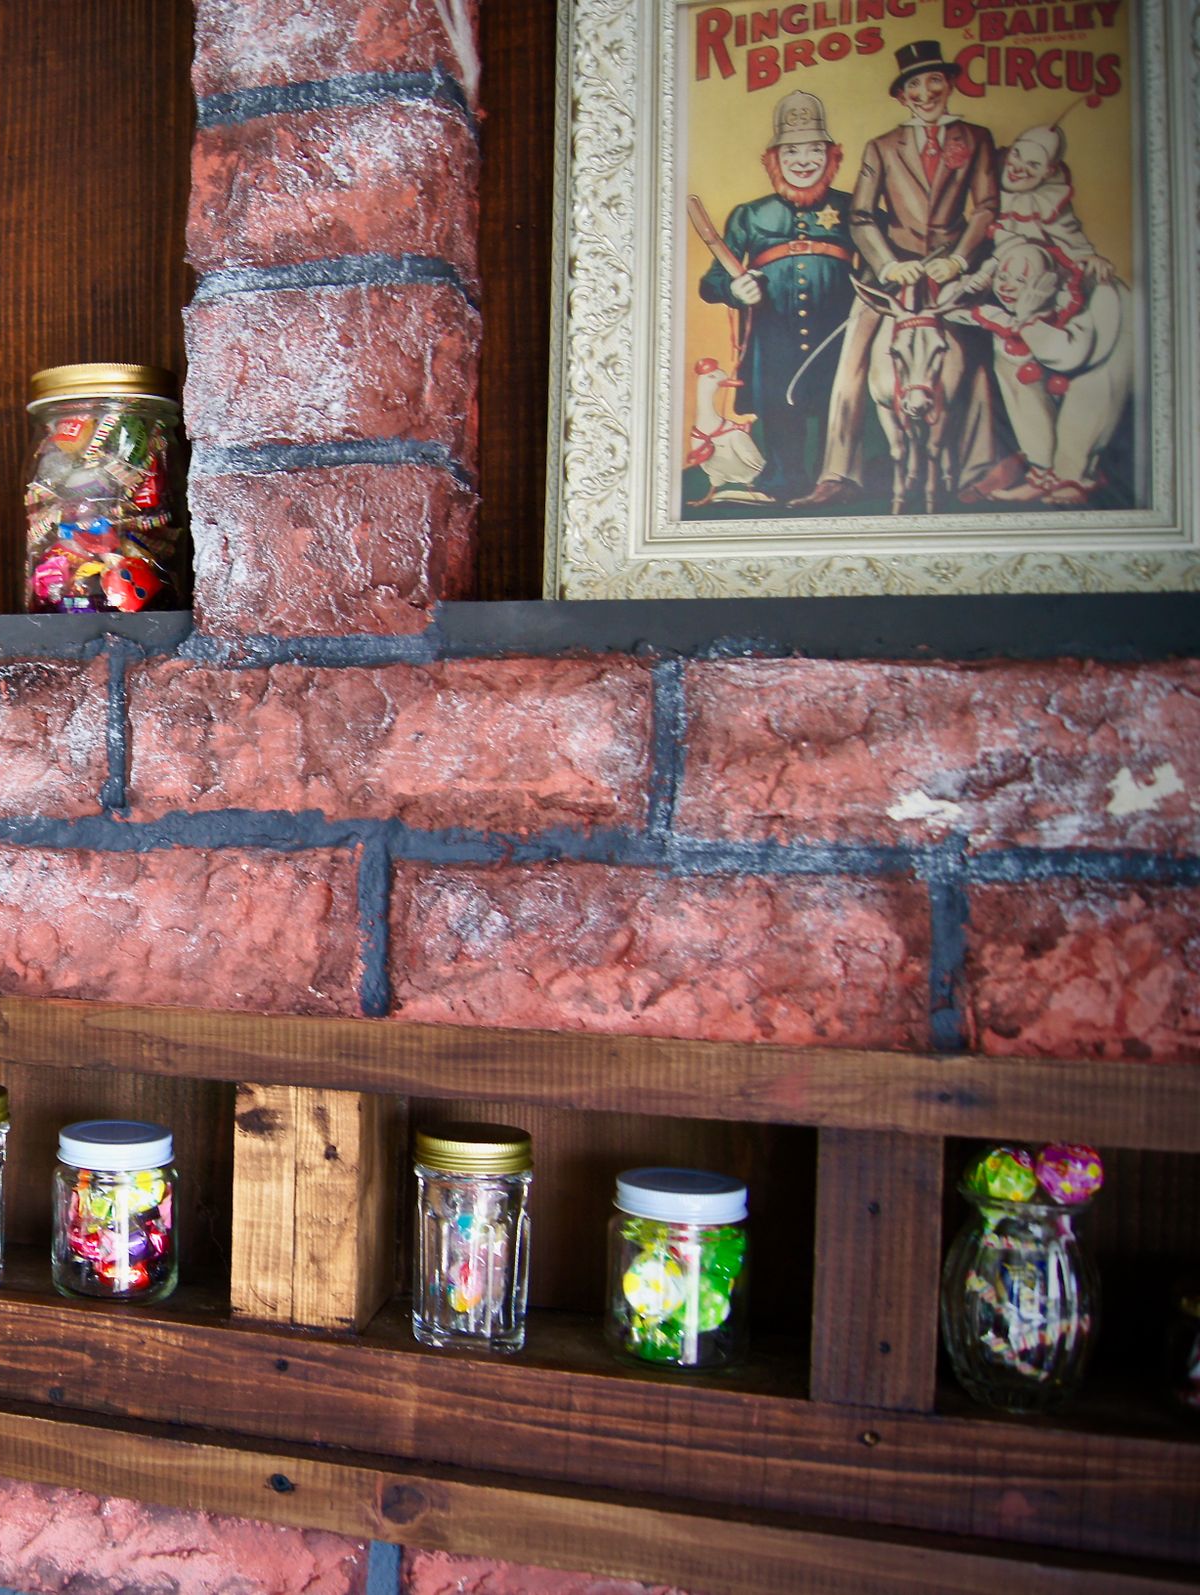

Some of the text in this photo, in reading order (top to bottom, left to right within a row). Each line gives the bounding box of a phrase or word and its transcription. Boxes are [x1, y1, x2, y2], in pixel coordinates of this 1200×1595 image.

[696, 0, 916, 81] RINGLING
[962, 28, 976, 41] &
[979, 2, 1121, 42] BAILEY
[747, 27, 885, 92] BROS
[954, 44, 1122, 97] CIRCUS
